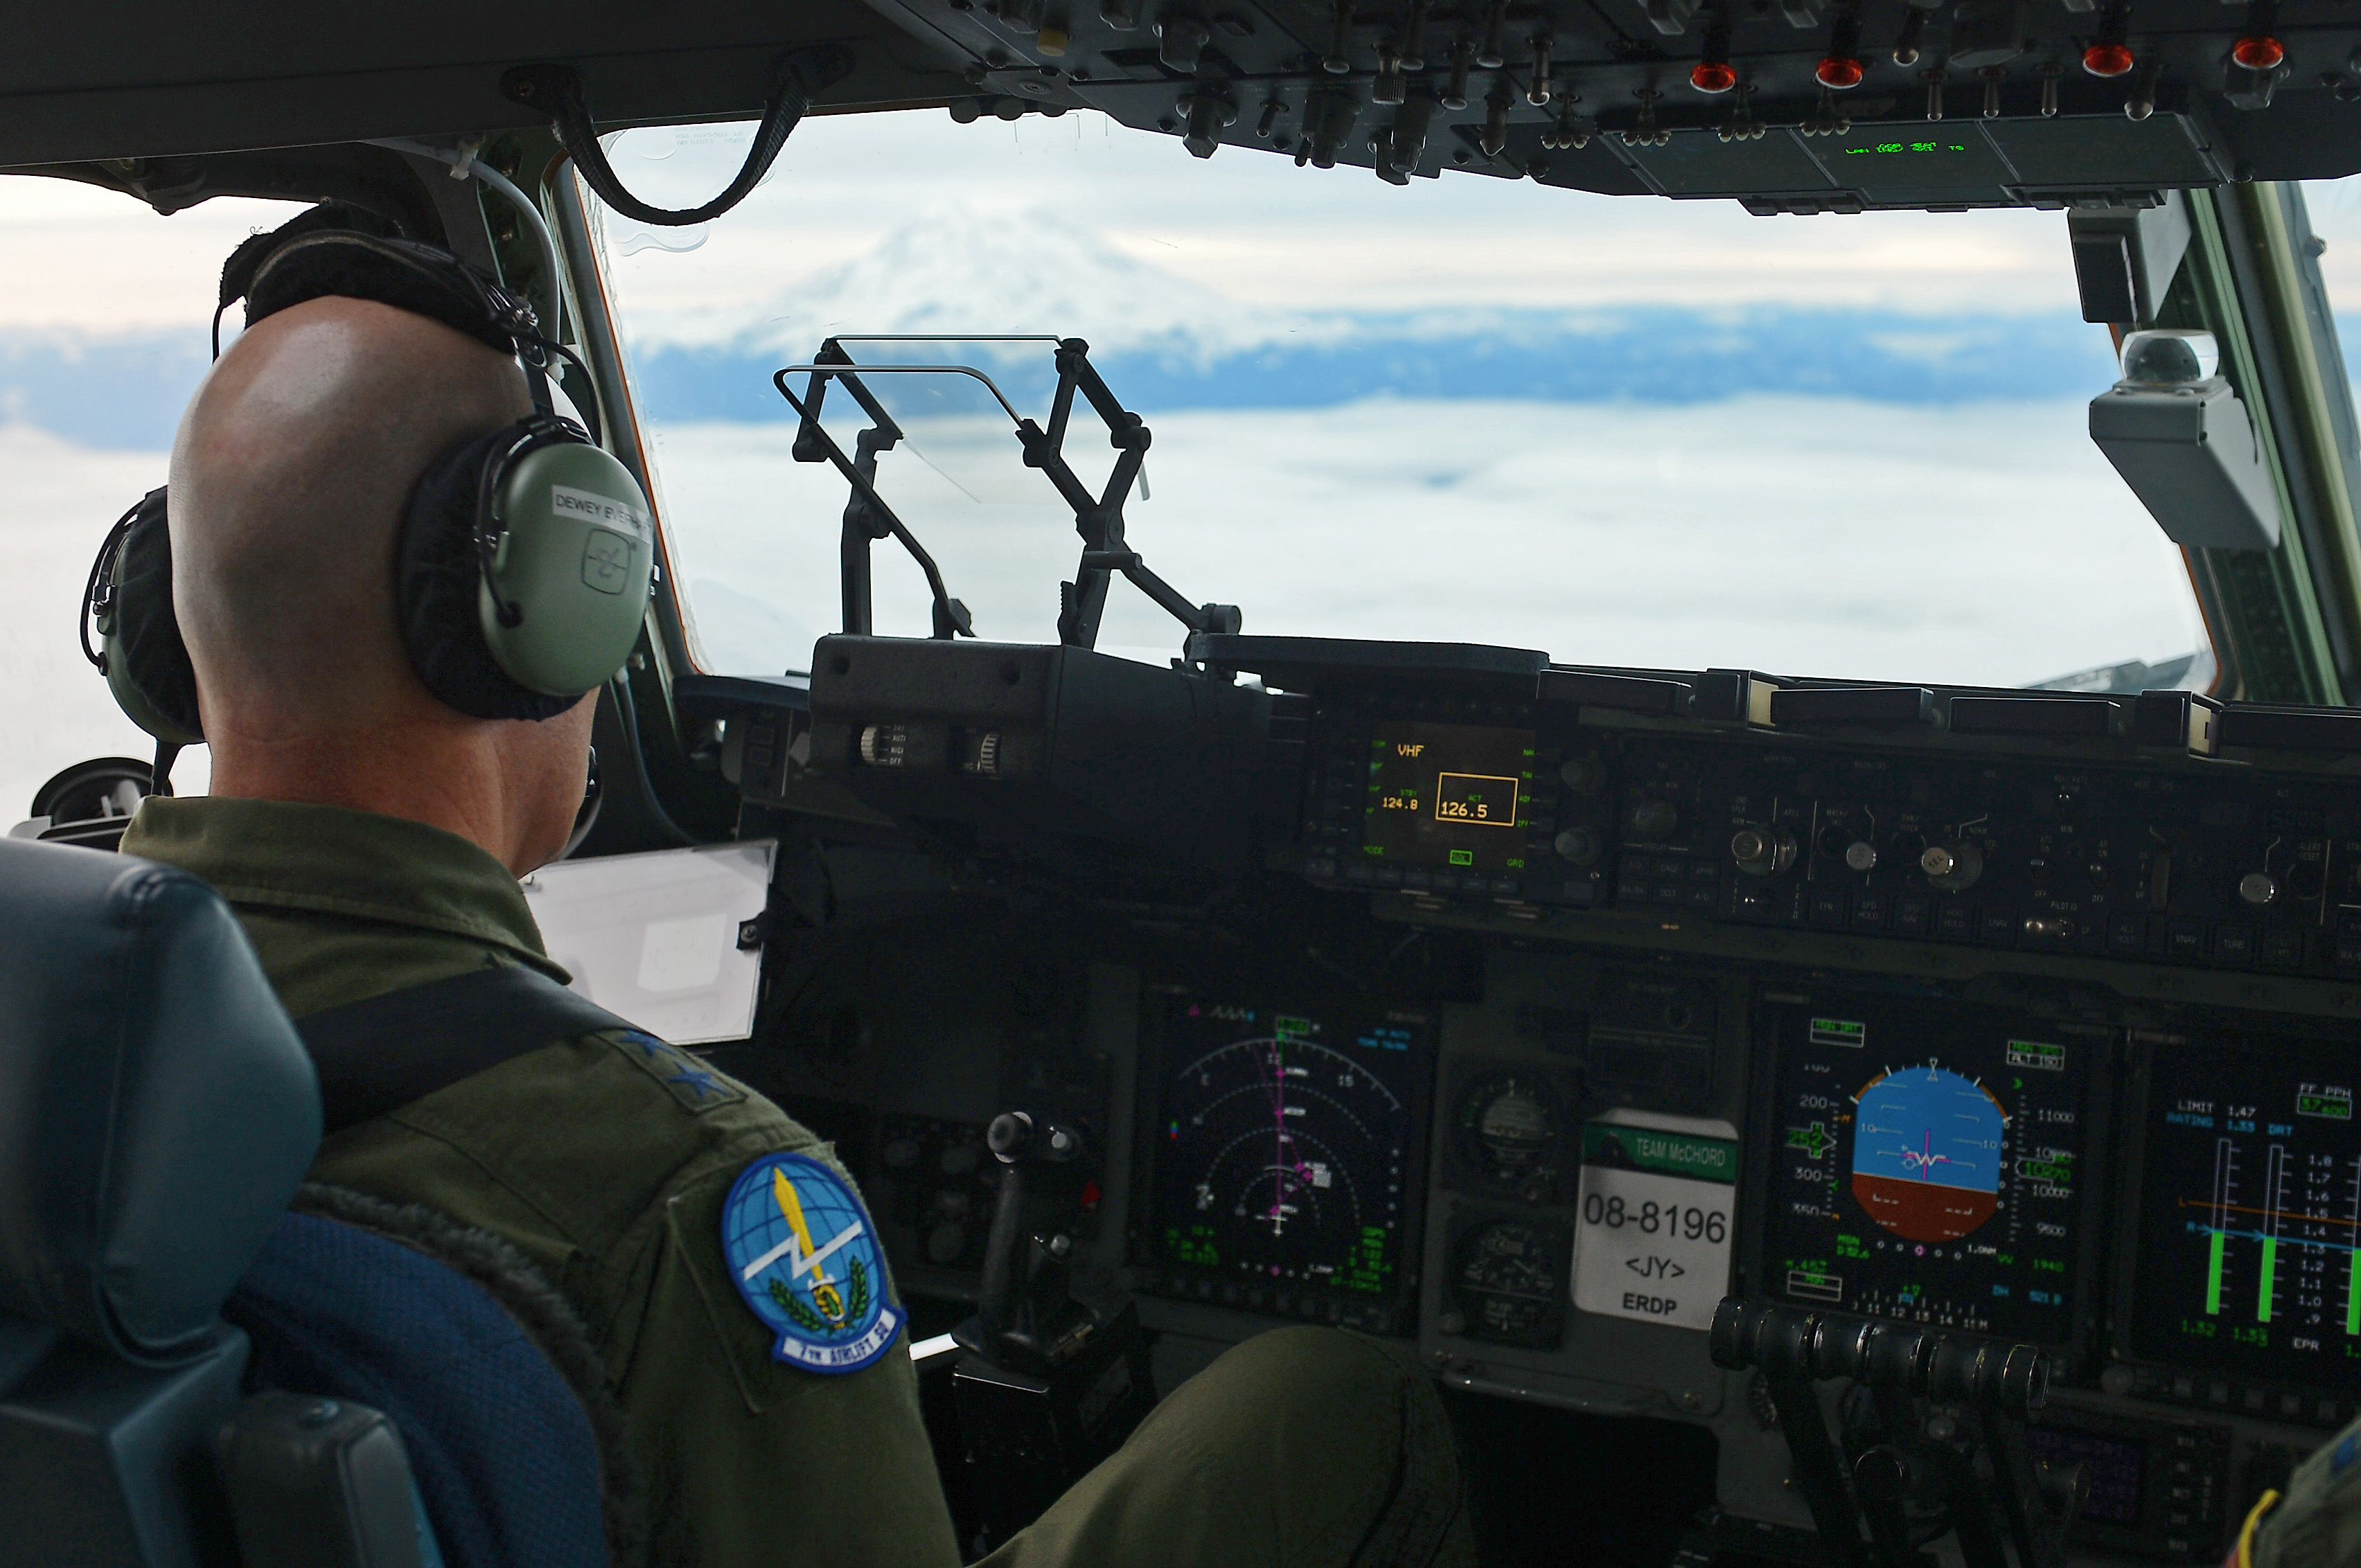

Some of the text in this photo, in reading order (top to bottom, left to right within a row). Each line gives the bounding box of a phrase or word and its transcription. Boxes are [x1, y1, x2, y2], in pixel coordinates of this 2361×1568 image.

[556, 494, 601, 515] DEWEY
[1397, 743, 1424, 758] VHF
[1382, 796, 1418, 811] 124.8
[1441, 801, 1489, 819] 126.5
[1800, 1094, 1828, 1109] 200
[2177, 1100, 2256, 1119] LIMIT 1.47
[2166, 1111, 2214, 1128] RATING
[1636, 1137, 1726, 1166] TEAM McCHORD
[1584, 1194, 1726, 1244] 08-8196
[1625, 1256, 1686, 1280] <JY>
[1623, 1292, 1677, 1315] ERDP
[2298, 1294, 2322, 1308] 1.0
